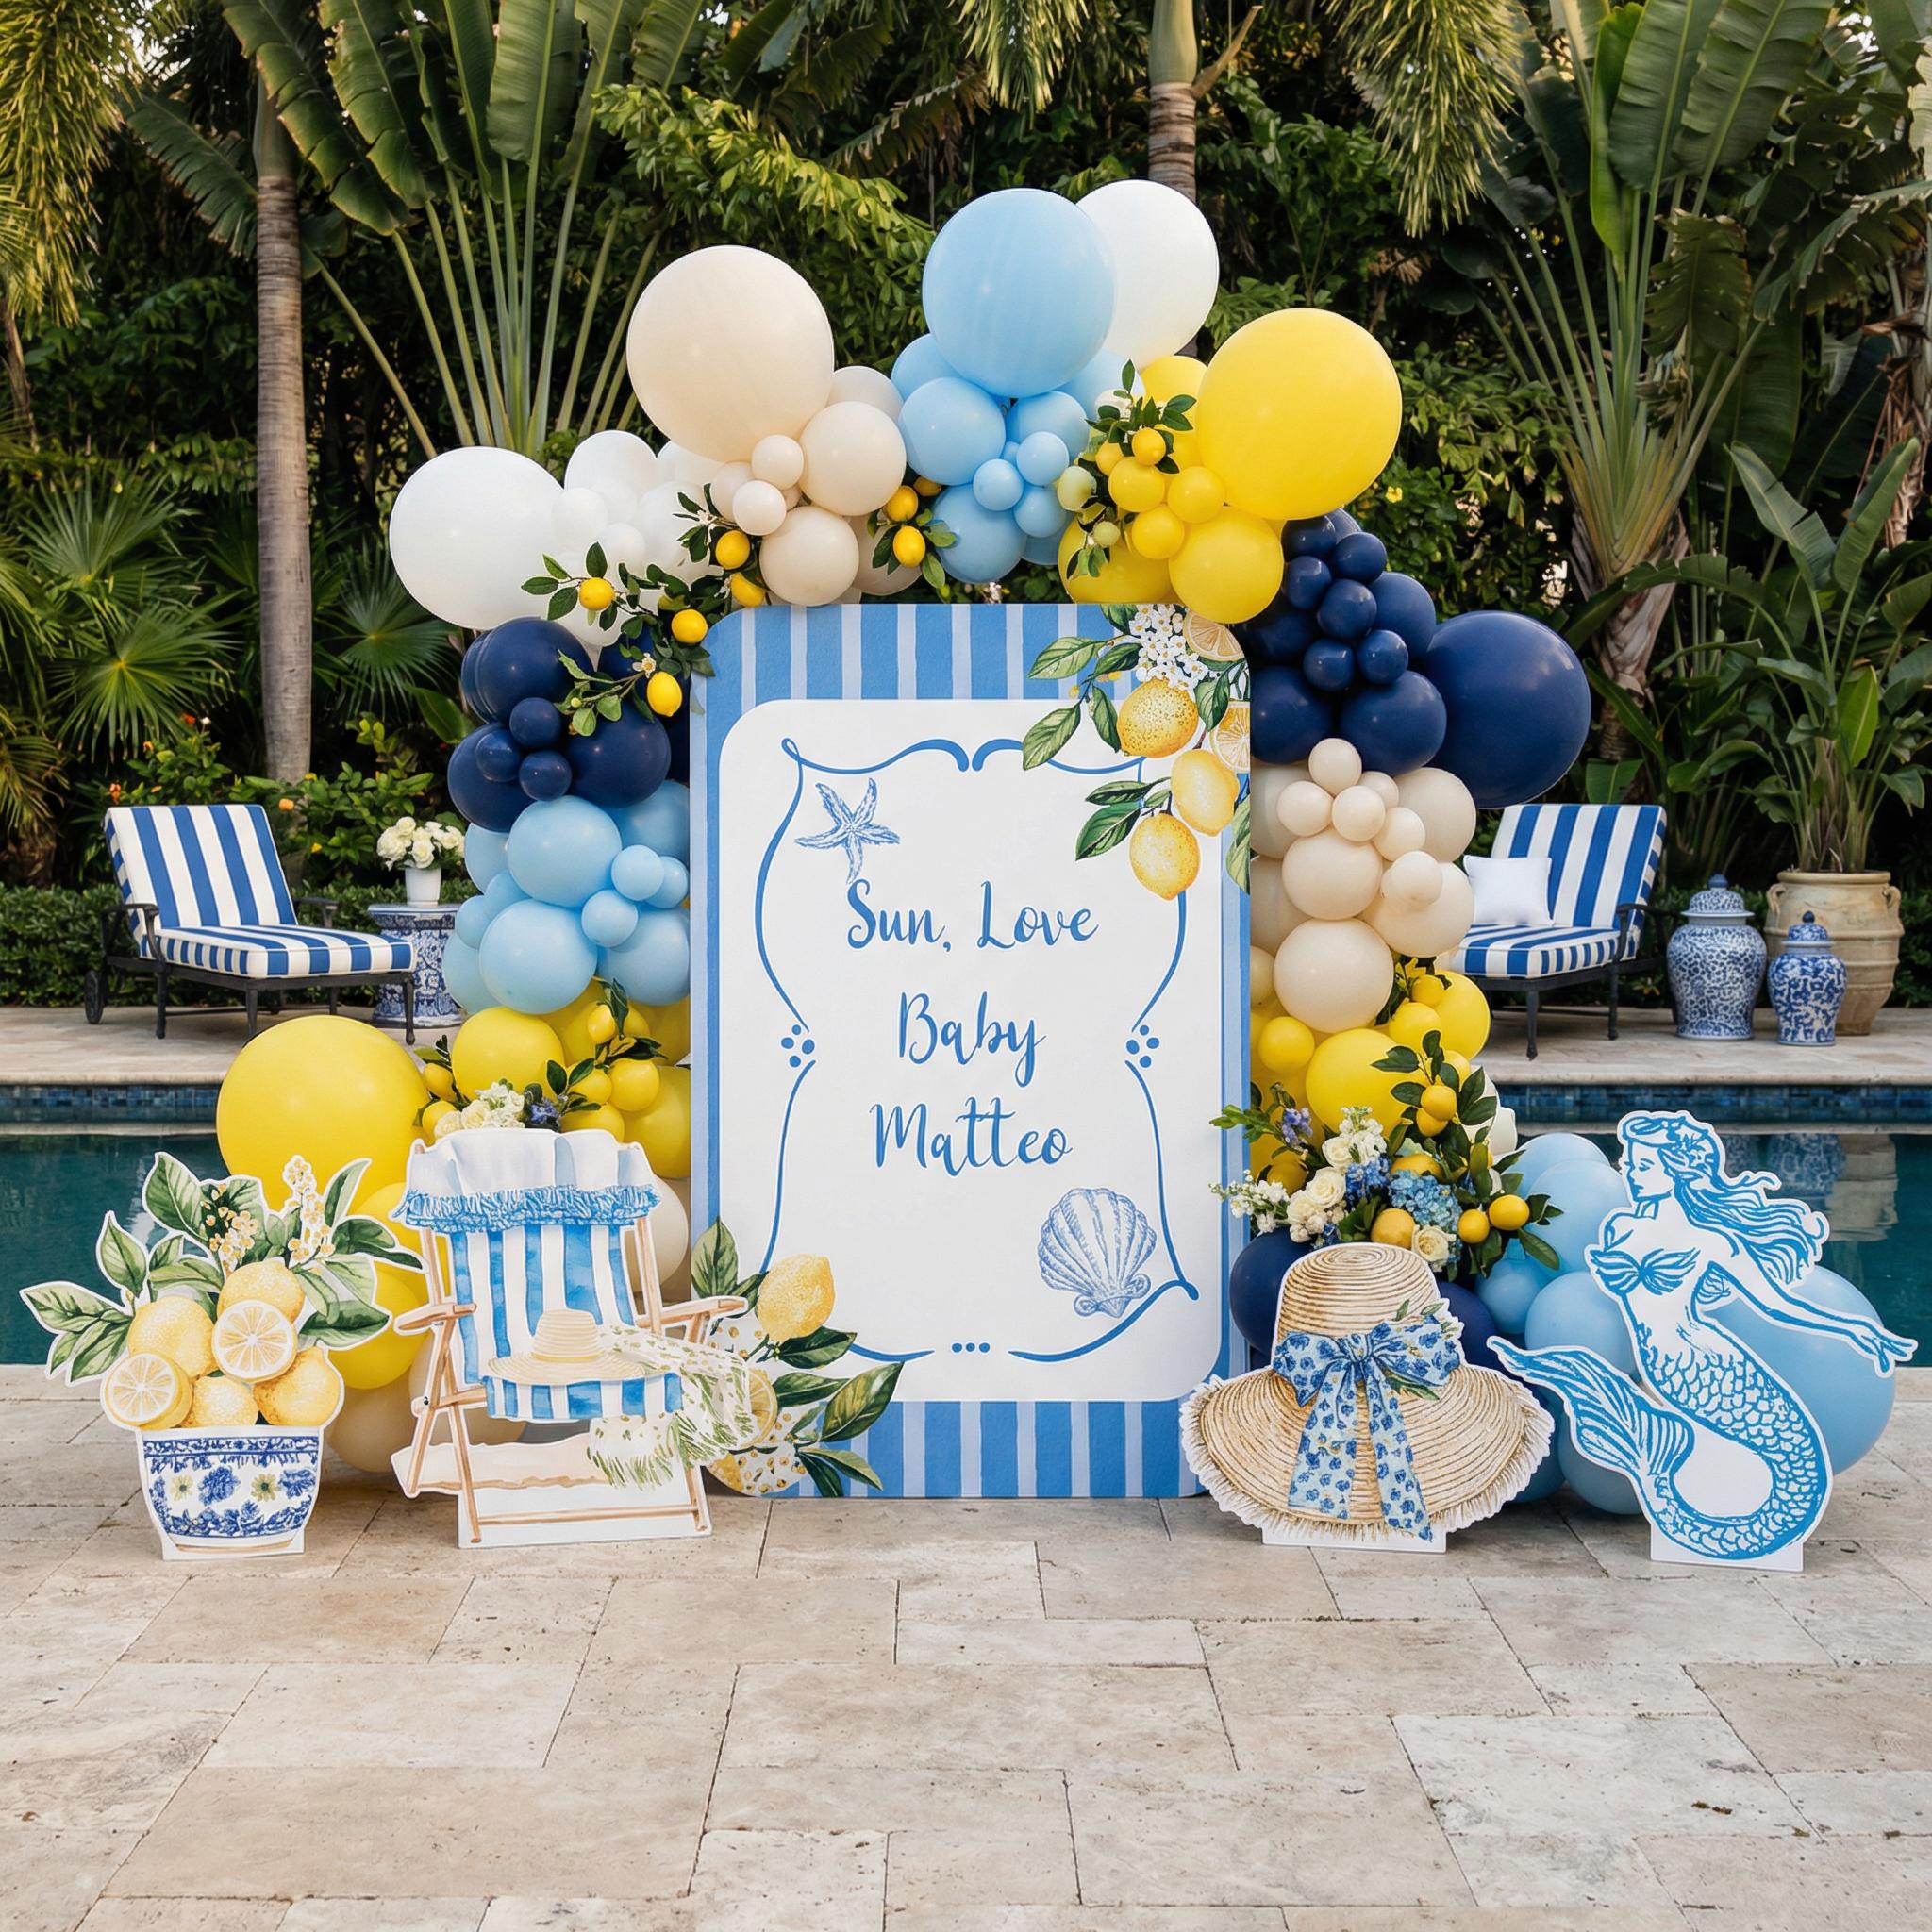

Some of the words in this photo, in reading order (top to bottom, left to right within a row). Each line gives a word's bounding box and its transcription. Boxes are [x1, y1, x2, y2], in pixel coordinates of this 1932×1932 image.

[847, 879, 951, 952] Sun,
[977, 881, 1099, 949] Love
[899, 991, 1046, 1088] Baby
[869, 1097, 1073, 1176] Matteo
